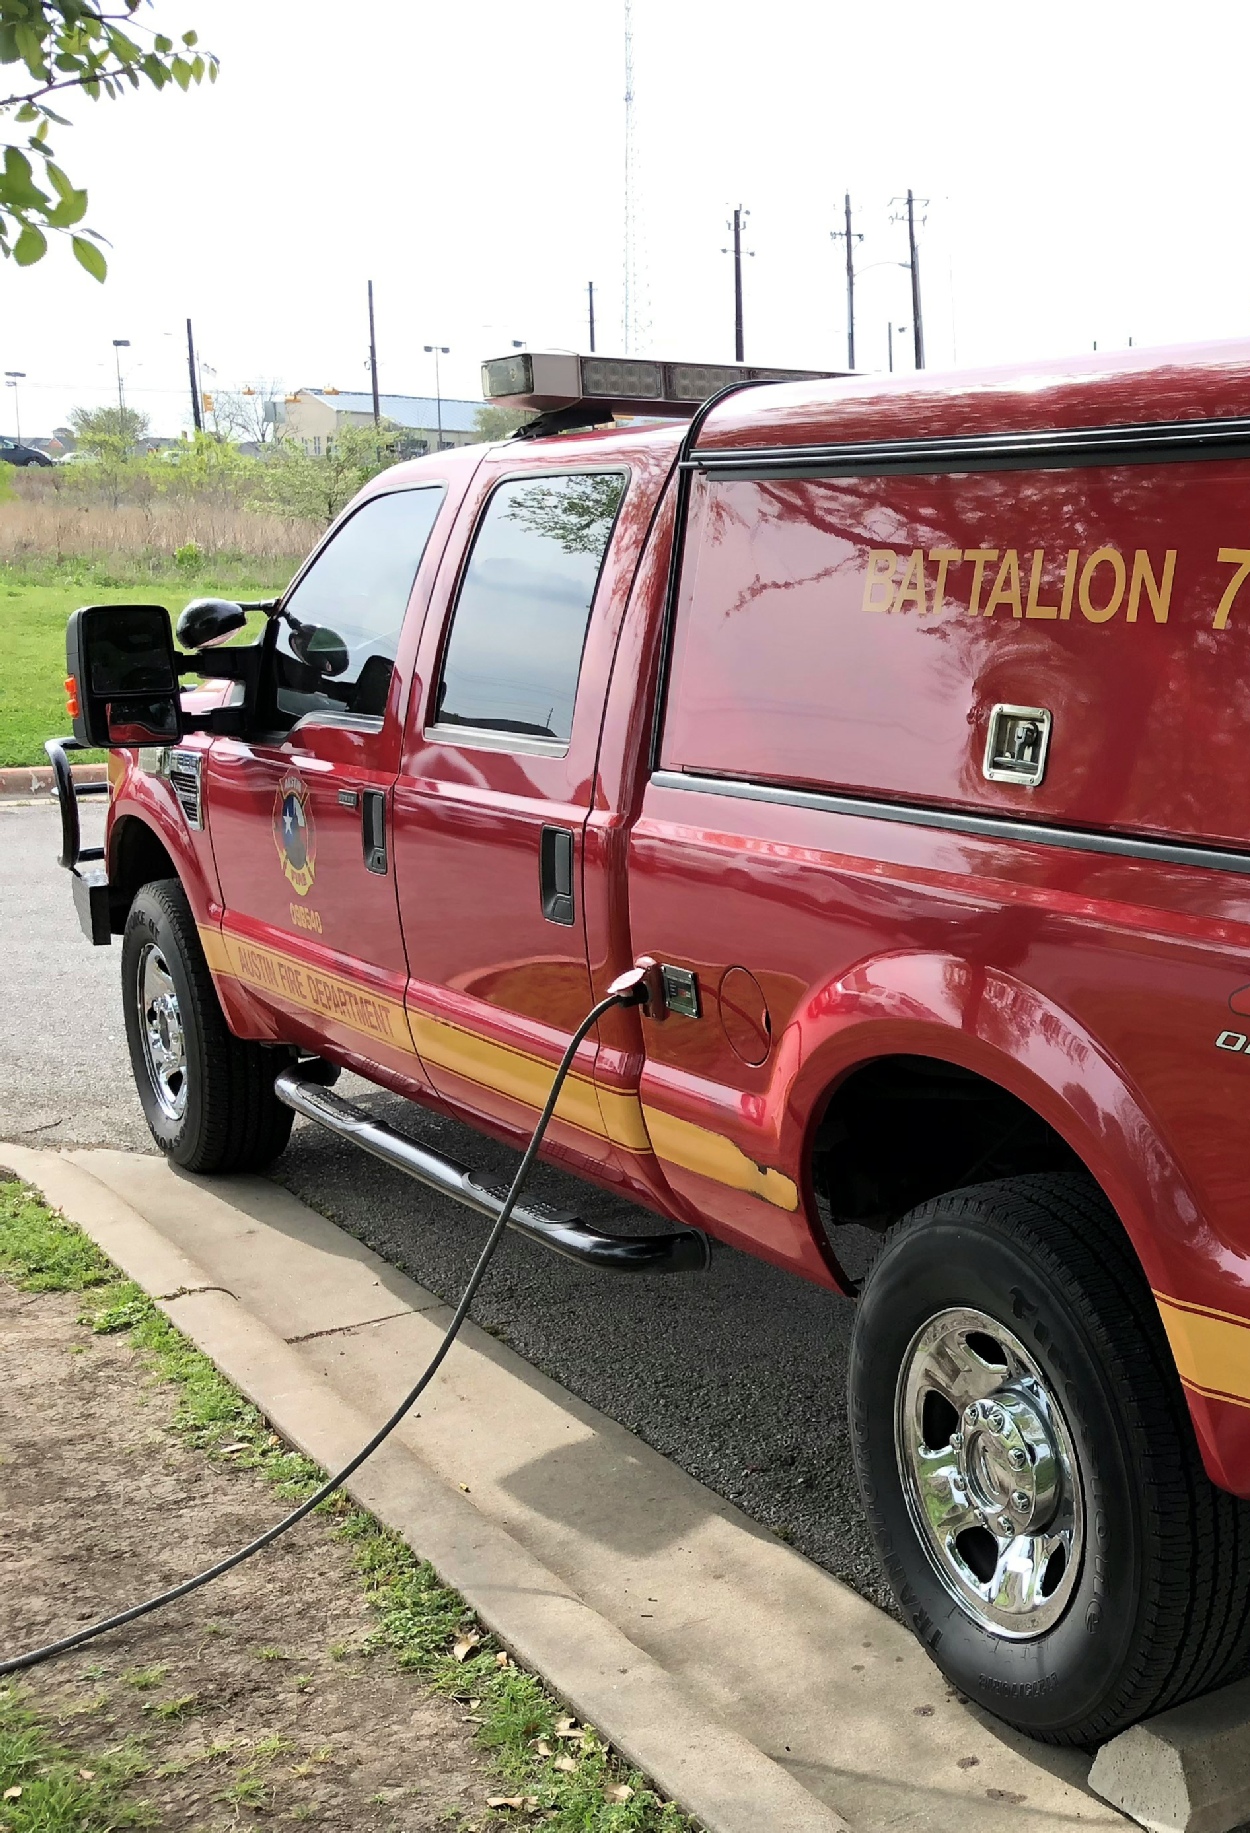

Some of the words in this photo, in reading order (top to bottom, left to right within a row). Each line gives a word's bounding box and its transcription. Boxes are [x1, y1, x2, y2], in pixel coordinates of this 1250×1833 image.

[860, 546, 1178, 625] BATTALION
[237, 946, 275, 986] AUSTIN
[278, 963, 308, 999] FIRE
[308, 974, 394, 1037] DEPARTMENT
